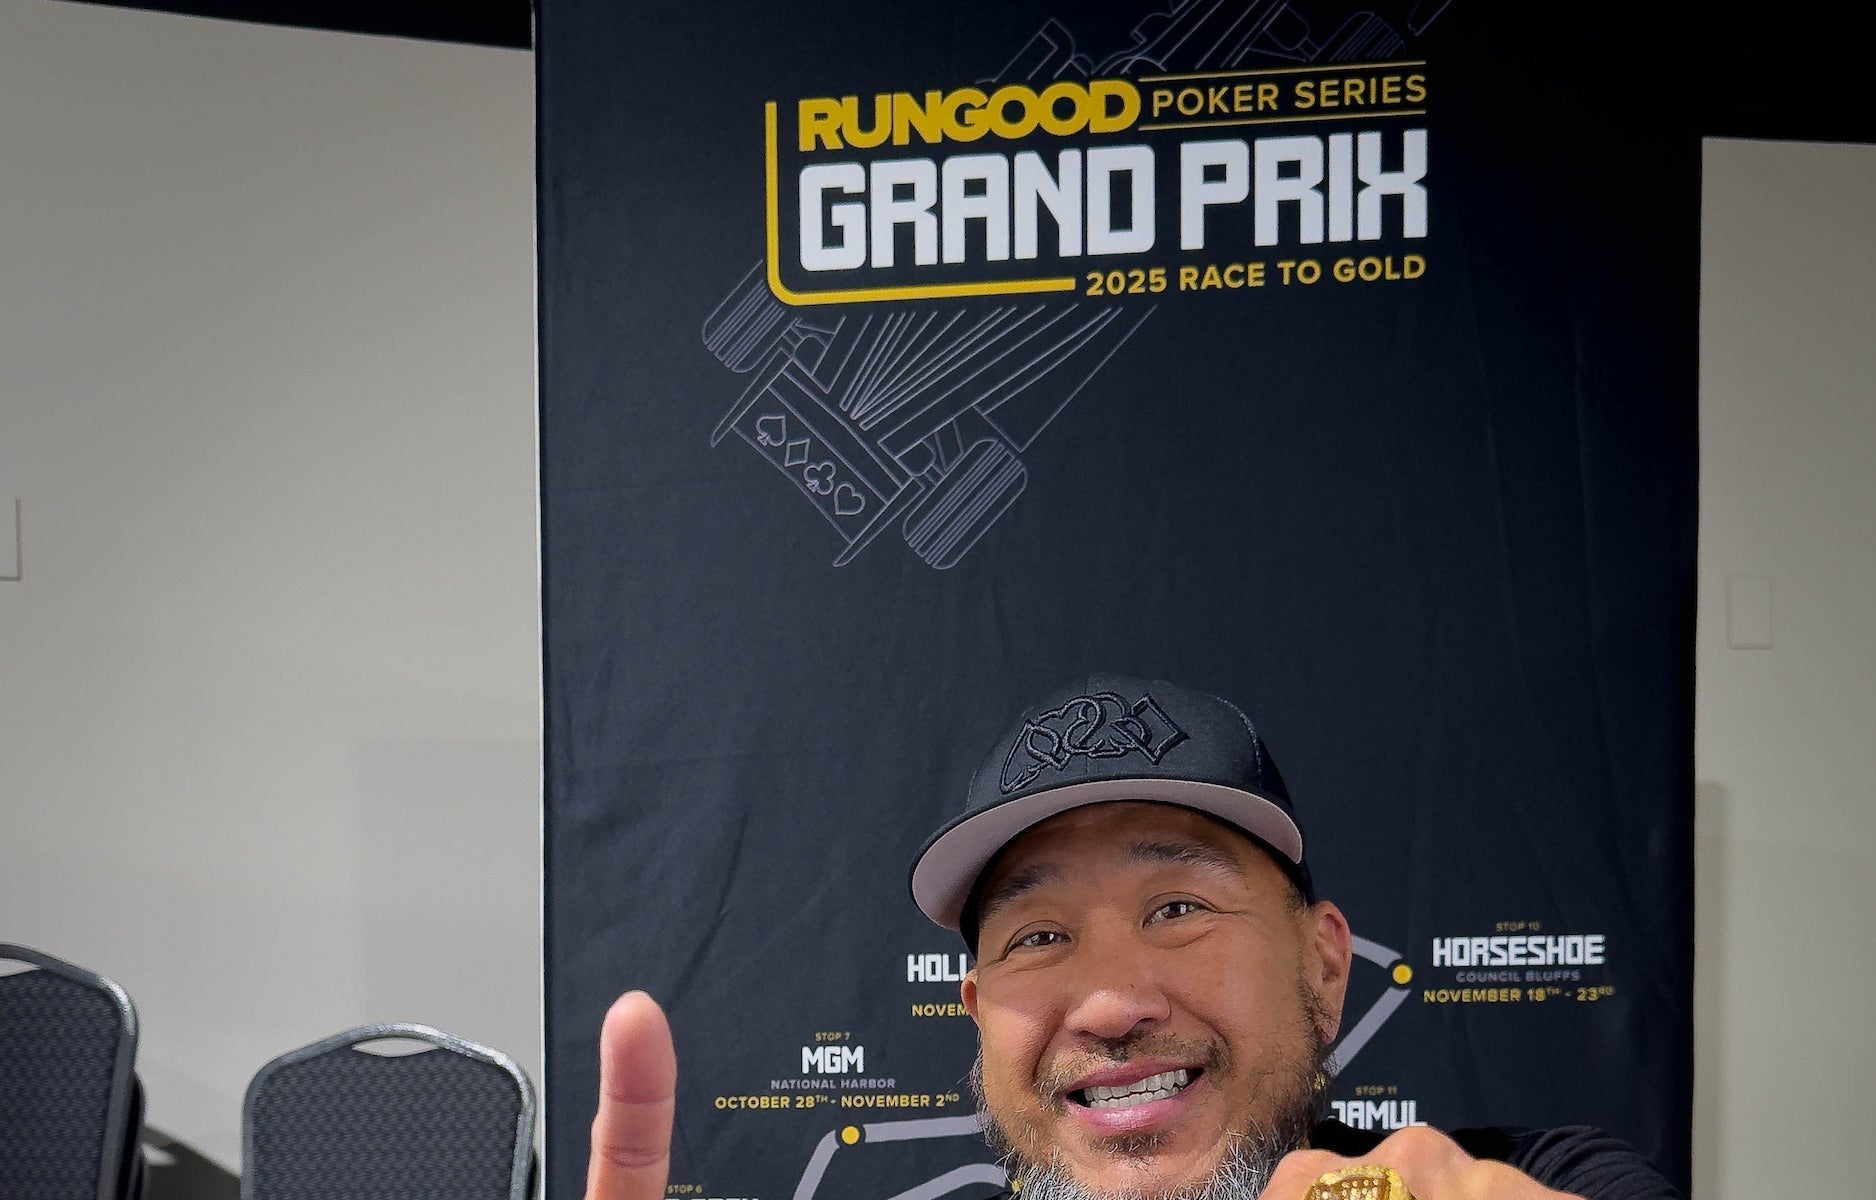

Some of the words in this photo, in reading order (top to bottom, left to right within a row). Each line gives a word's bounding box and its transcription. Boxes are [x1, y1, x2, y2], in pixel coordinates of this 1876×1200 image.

[1152, 85, 1279, 118] POKER
[1294, 76, 1427, 111] SERIES
[799, 79, 1141, 152] RUNGOOD
[799, 145, 1155, 272] GRAND
[1180, 129, 1428, 251] PRIX
[1086, 268, 1168, 296] 2025
[1179, 262, 1265, 292] RACE
[1277, 259, 1322, 288] TO
[1332, 254, 1426, 284] GOLD
[1496, 921, 1526, 932] STOP
[1528, 920, 1541, 931] 10
[1432, 934, 1606, 967] HORSESHOE
[1455, 971, 1522, 983] COUNCIL
[1525, 969, 1582, 982] BLUFFS
[1423, 988, 1522, 1003] NOVEMBER
[815, 1032, 842, 1042] STOP
[844, 1032, 851, 1041] 7
[801, 1046, 865, 1074] MGM
[770, 1079, 837, 1090] NATIONAL
[840, 1079, 896, 1089] HARBOR
[1355, 1085, 1385, 1096] STOP
[715, 1096, 791, 1109] OCTOBER
[841, 1095, 930, 1108] NOVEMBER
[1327, 1099, 1429, 1131] JAMUL
[667, 1184, 694, 1194] STOP
